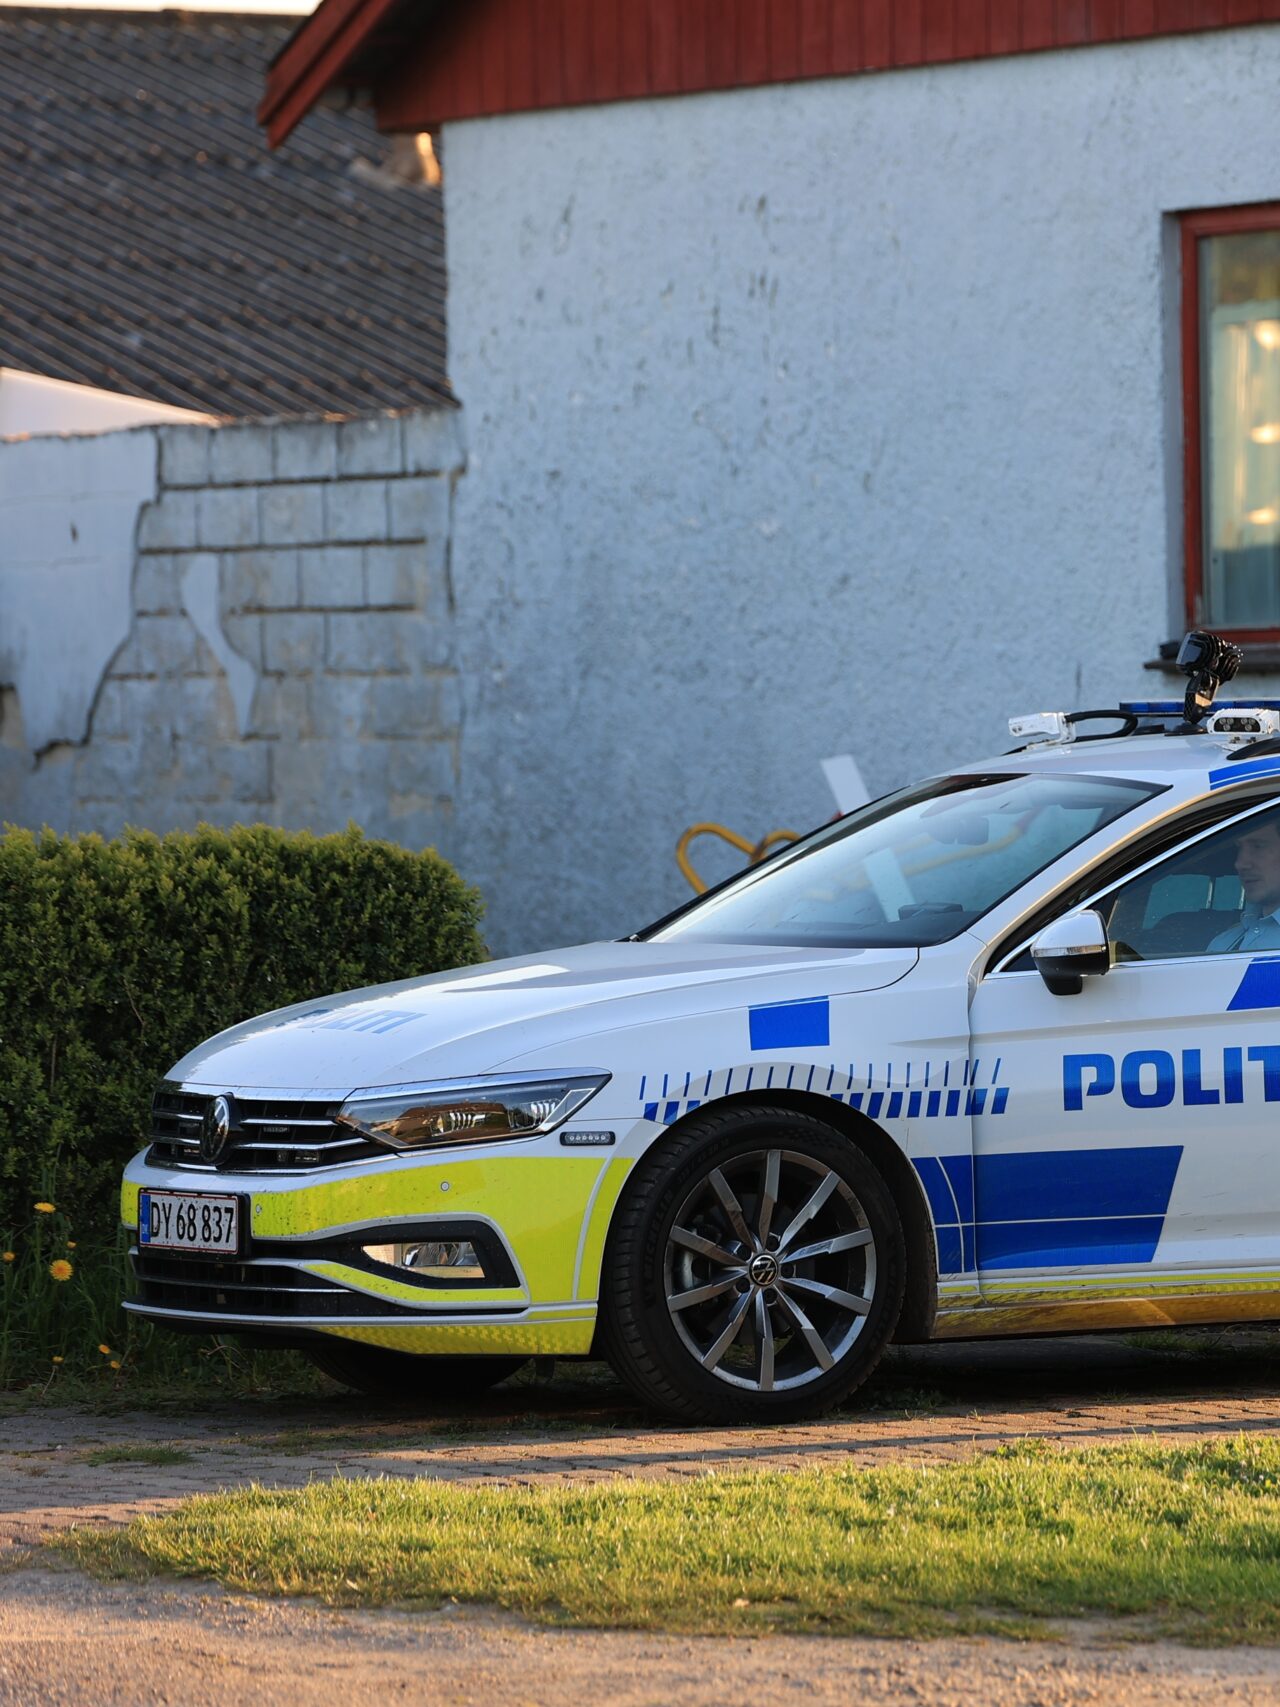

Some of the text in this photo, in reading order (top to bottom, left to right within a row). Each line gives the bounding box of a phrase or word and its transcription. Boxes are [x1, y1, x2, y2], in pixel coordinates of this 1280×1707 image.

[151, 1202, 234, 1243] DY 68 837
